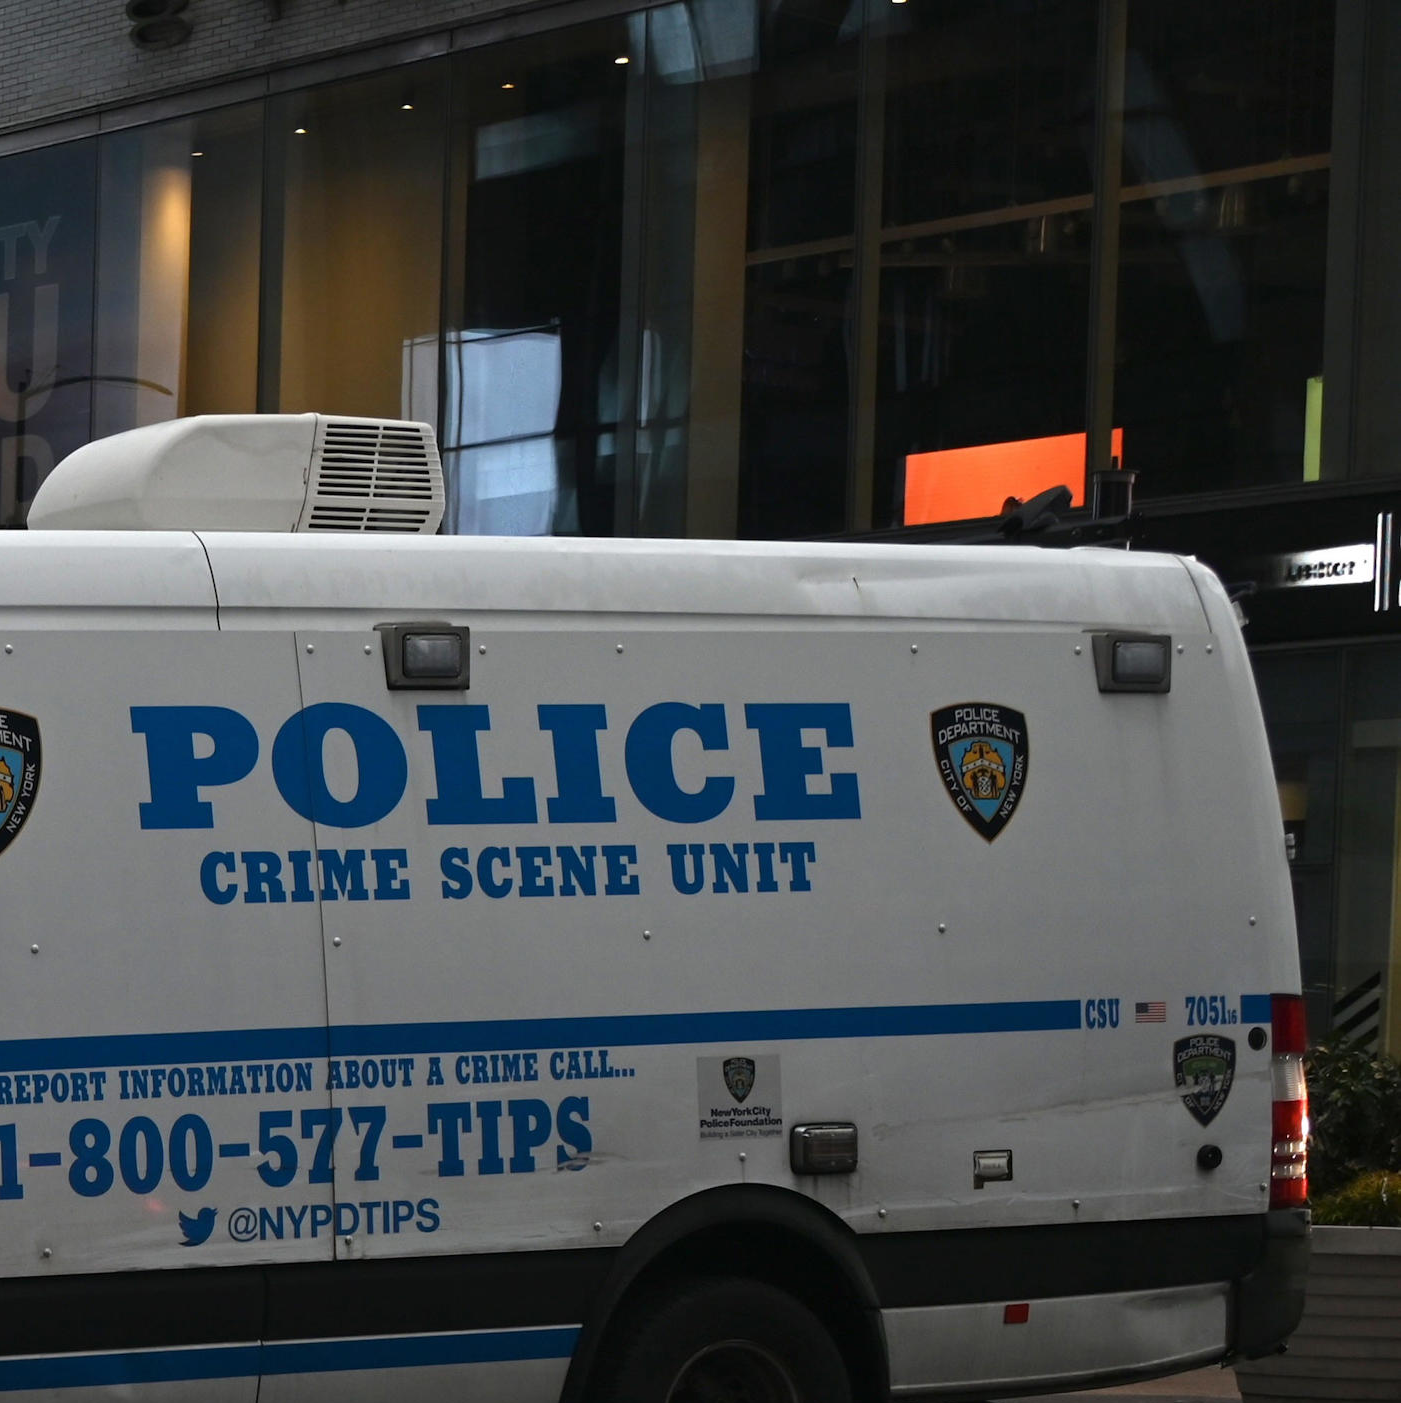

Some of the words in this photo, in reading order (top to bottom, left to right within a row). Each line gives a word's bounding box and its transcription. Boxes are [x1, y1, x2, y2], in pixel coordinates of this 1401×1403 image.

[938, 721, 1021, 745] DEPARTMENT
[954, 708, 1000, 723] POLICE
[129, 701, 862, 830] POLICE
[6, 803, 27, 833] NEW
[21, 763, 36, 799] YORK
[940, 759, 959, 792] CITY
[956, 795, 973, 813] OF
[999, 790, 1017, 818] NEW
[1012, 754, 1024, 786] YORK
[199, 847, 410, 905] CRIME
[440, 843, 640, 900] SCENE
[665, 840, 817, 896] UNIT
[1085, 998, 1121, 1029] CSU
[1177, 1048, 1232, 1064] DEPARTMENT
[1189, 1037, 1221, 1047] POLICE
[119, 1062, 313, 1100] INFORMATION
[326, 1057, 415, 1090] ABOUT
[427, 1057, 444, 1086] A
[455, 1052, 539, 1085] CRIME
[550, 1049, 635, 1080] CALL...
[700, 1119, 730, 1128] Police
[730, 1117, 782, 1127] Foundation
[711, 1108, 731, 1117] New
[731, 1107, 751, 1116] York
[752, 1107, 772, 1118] City
[228, 1197, 440, 1242] @NYPDTIPS
